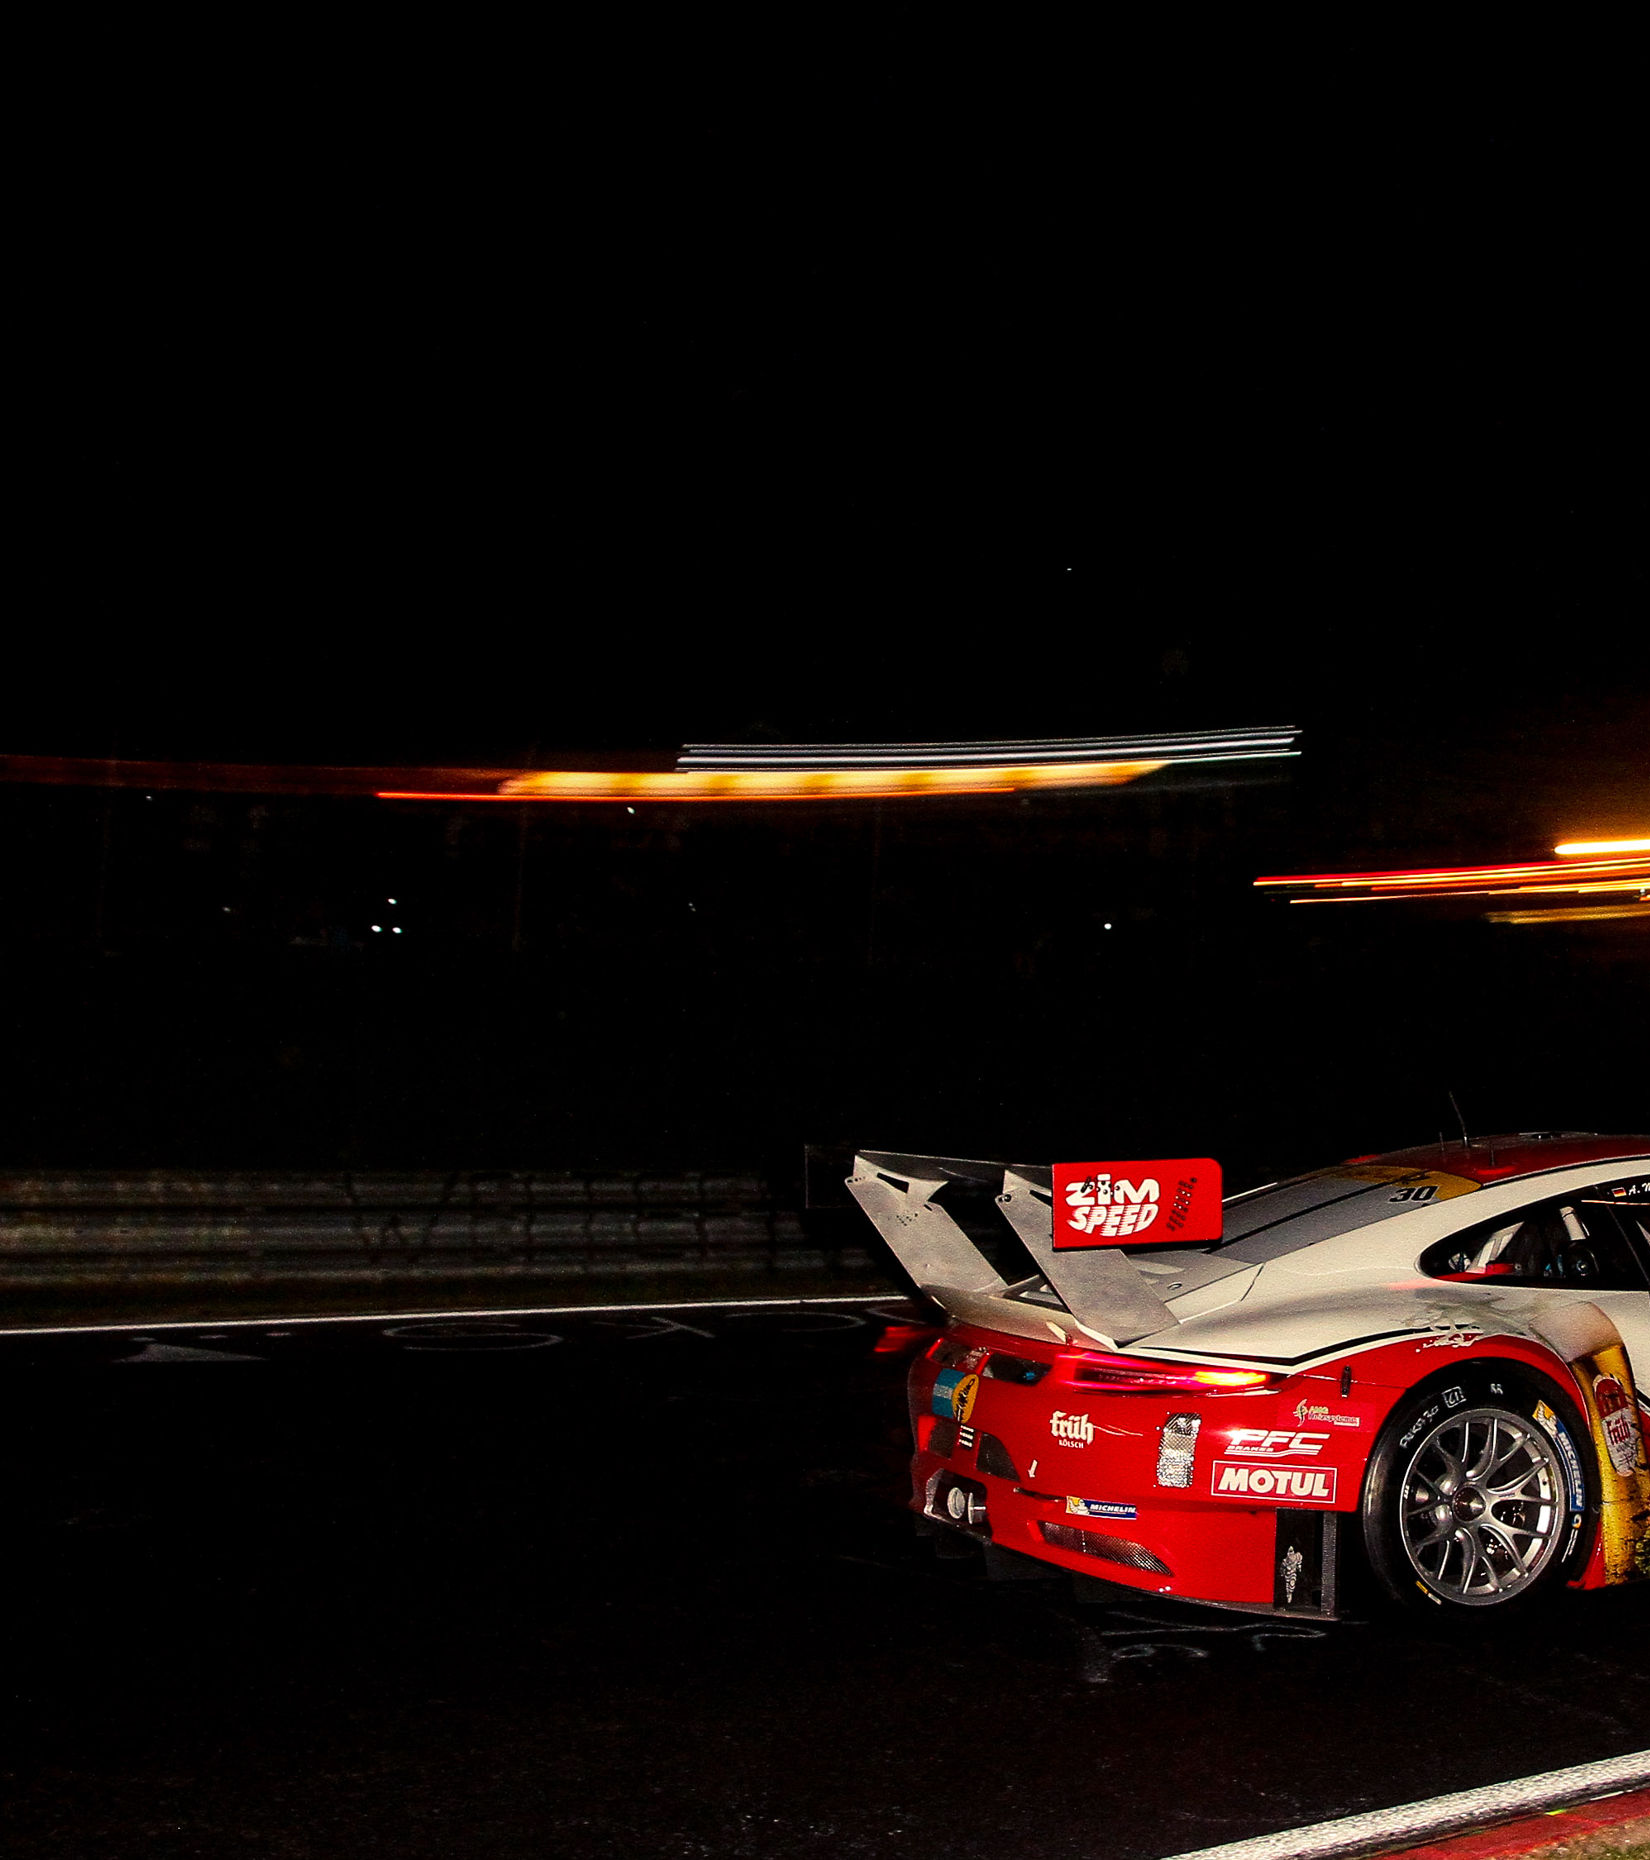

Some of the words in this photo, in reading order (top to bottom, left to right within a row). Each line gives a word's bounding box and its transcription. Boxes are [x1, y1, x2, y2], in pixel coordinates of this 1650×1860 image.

[1389, 1185, 1439, 1202] 30
[1066, 1203, 1159, 1237] SPEED
[1050, 1410, 1095, 1445] früh
[1230, 1428, 1331, 1451] PFC
[1217, 1467, 1330, 1498] MOTUL
[1559, 1431, 1585, 1508] MICHELIN
[1089, 1503, 1137, 1514] MICHELIN
